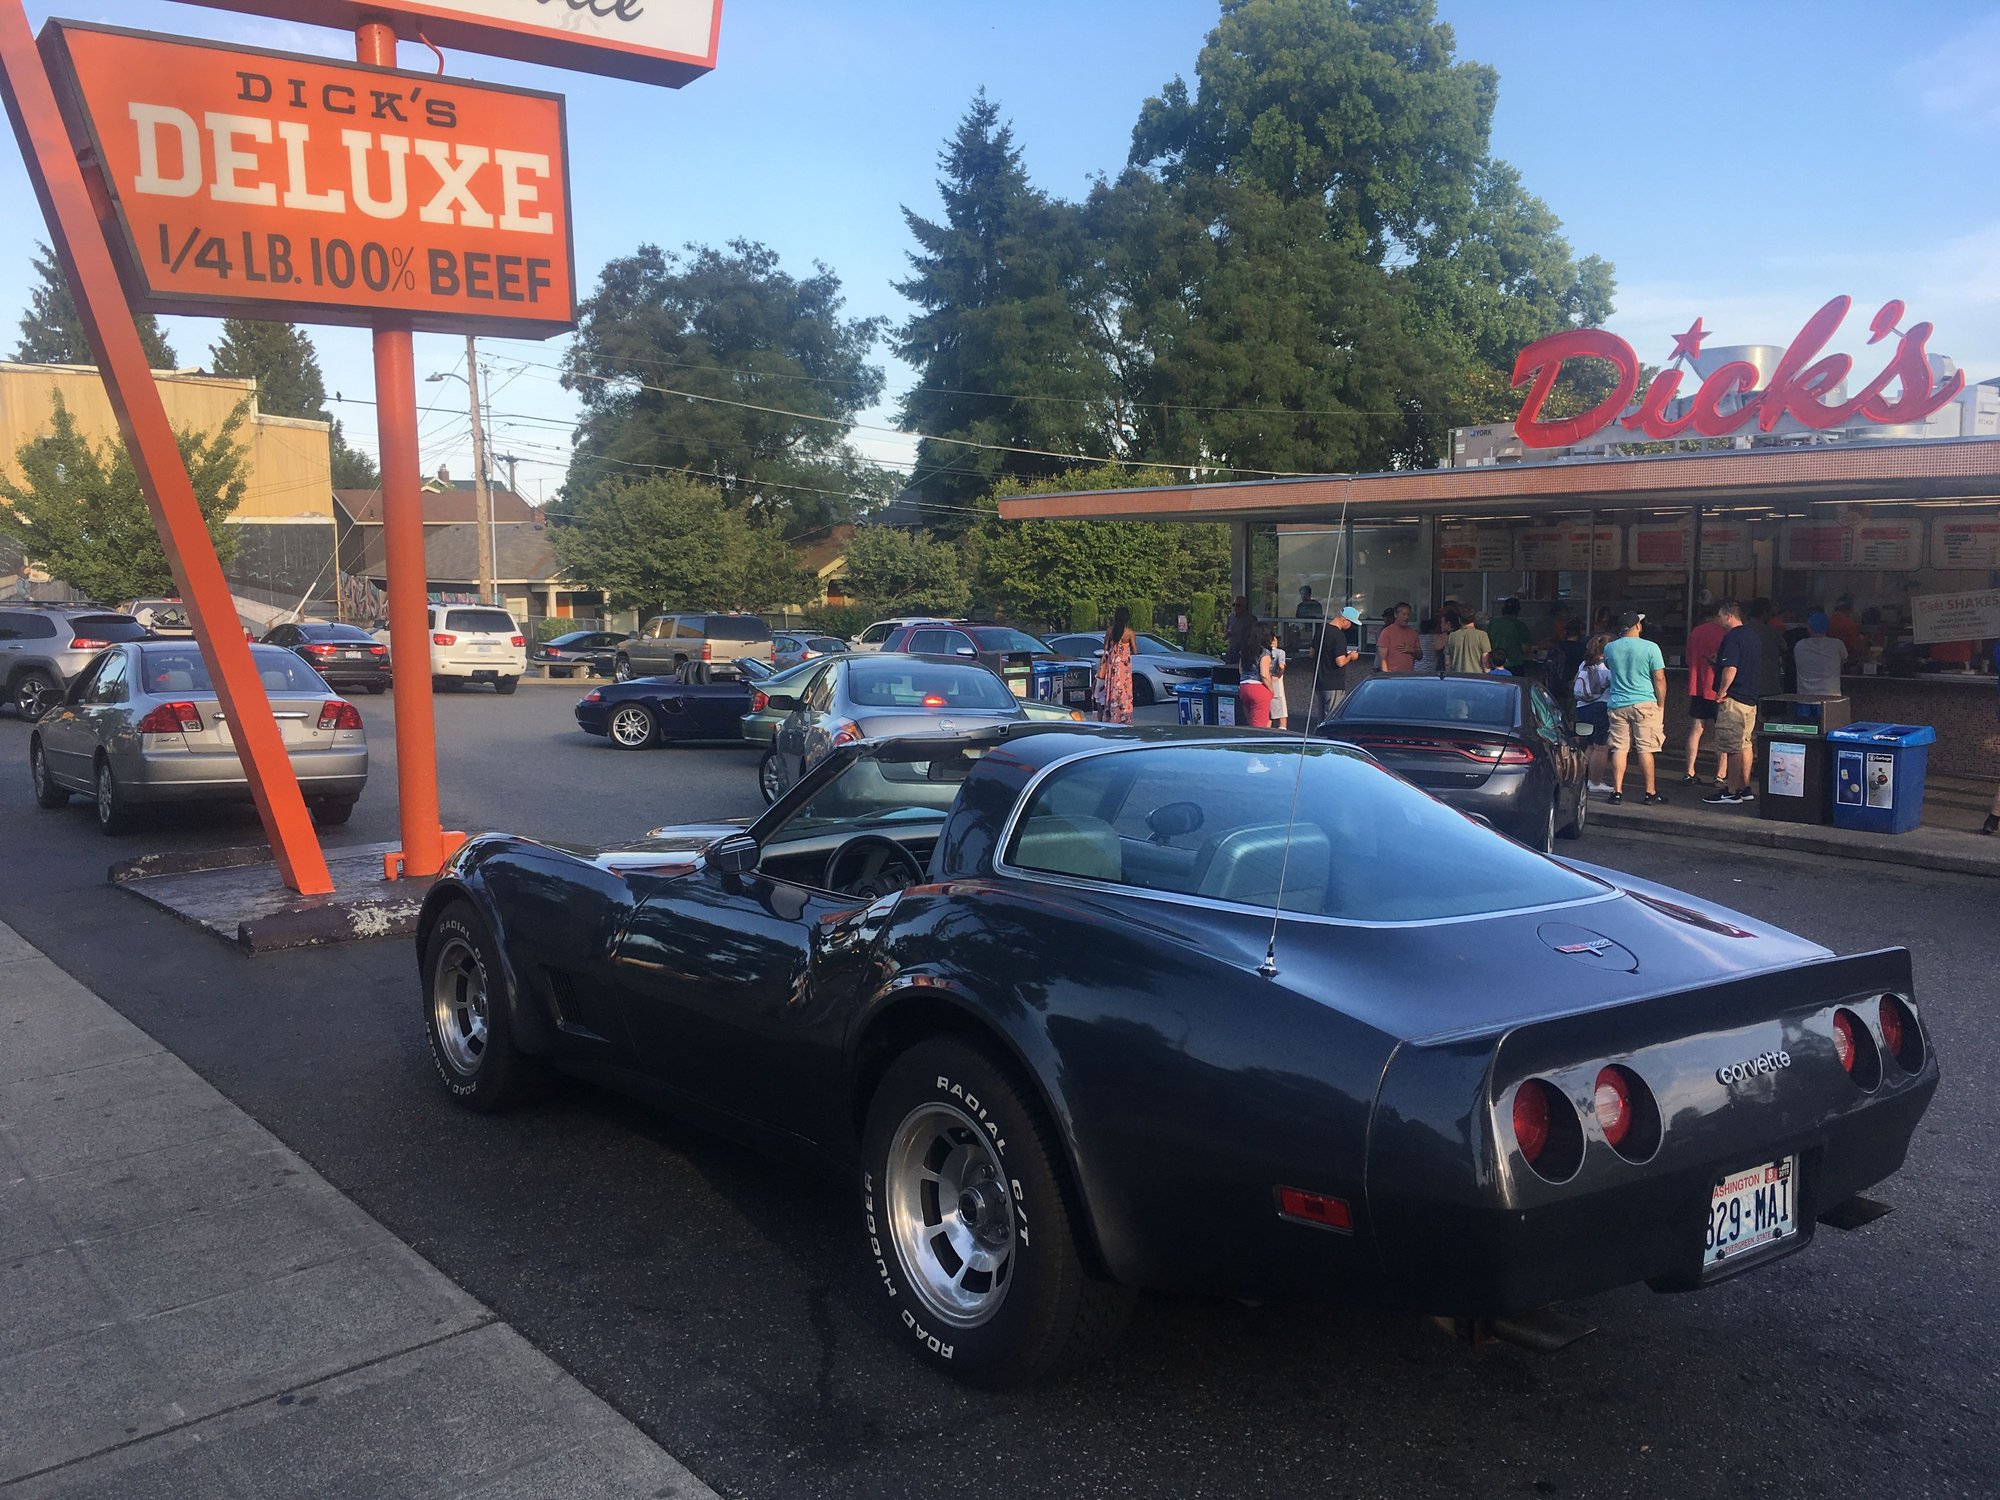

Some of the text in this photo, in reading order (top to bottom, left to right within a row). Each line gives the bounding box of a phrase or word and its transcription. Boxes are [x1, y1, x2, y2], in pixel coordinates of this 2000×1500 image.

[235, 71, 457, 128] DICK'S
[128, 102, 554, 235] DELUXE
[159, 223, 551, 303] 1/4 LB. 100% BEEF
[1511, 294, 1966, 448] Dick's
[440, 920, 471, 942] RADIAL
[452, 1081, 477, 1096] ROAD
[936, 1075, 1030, 1247] RADIAL G/T
[1713, 1173, 1760, 1199] ASHINGTON
[863, 1171, 955, 1360] ROAD HUGGER
